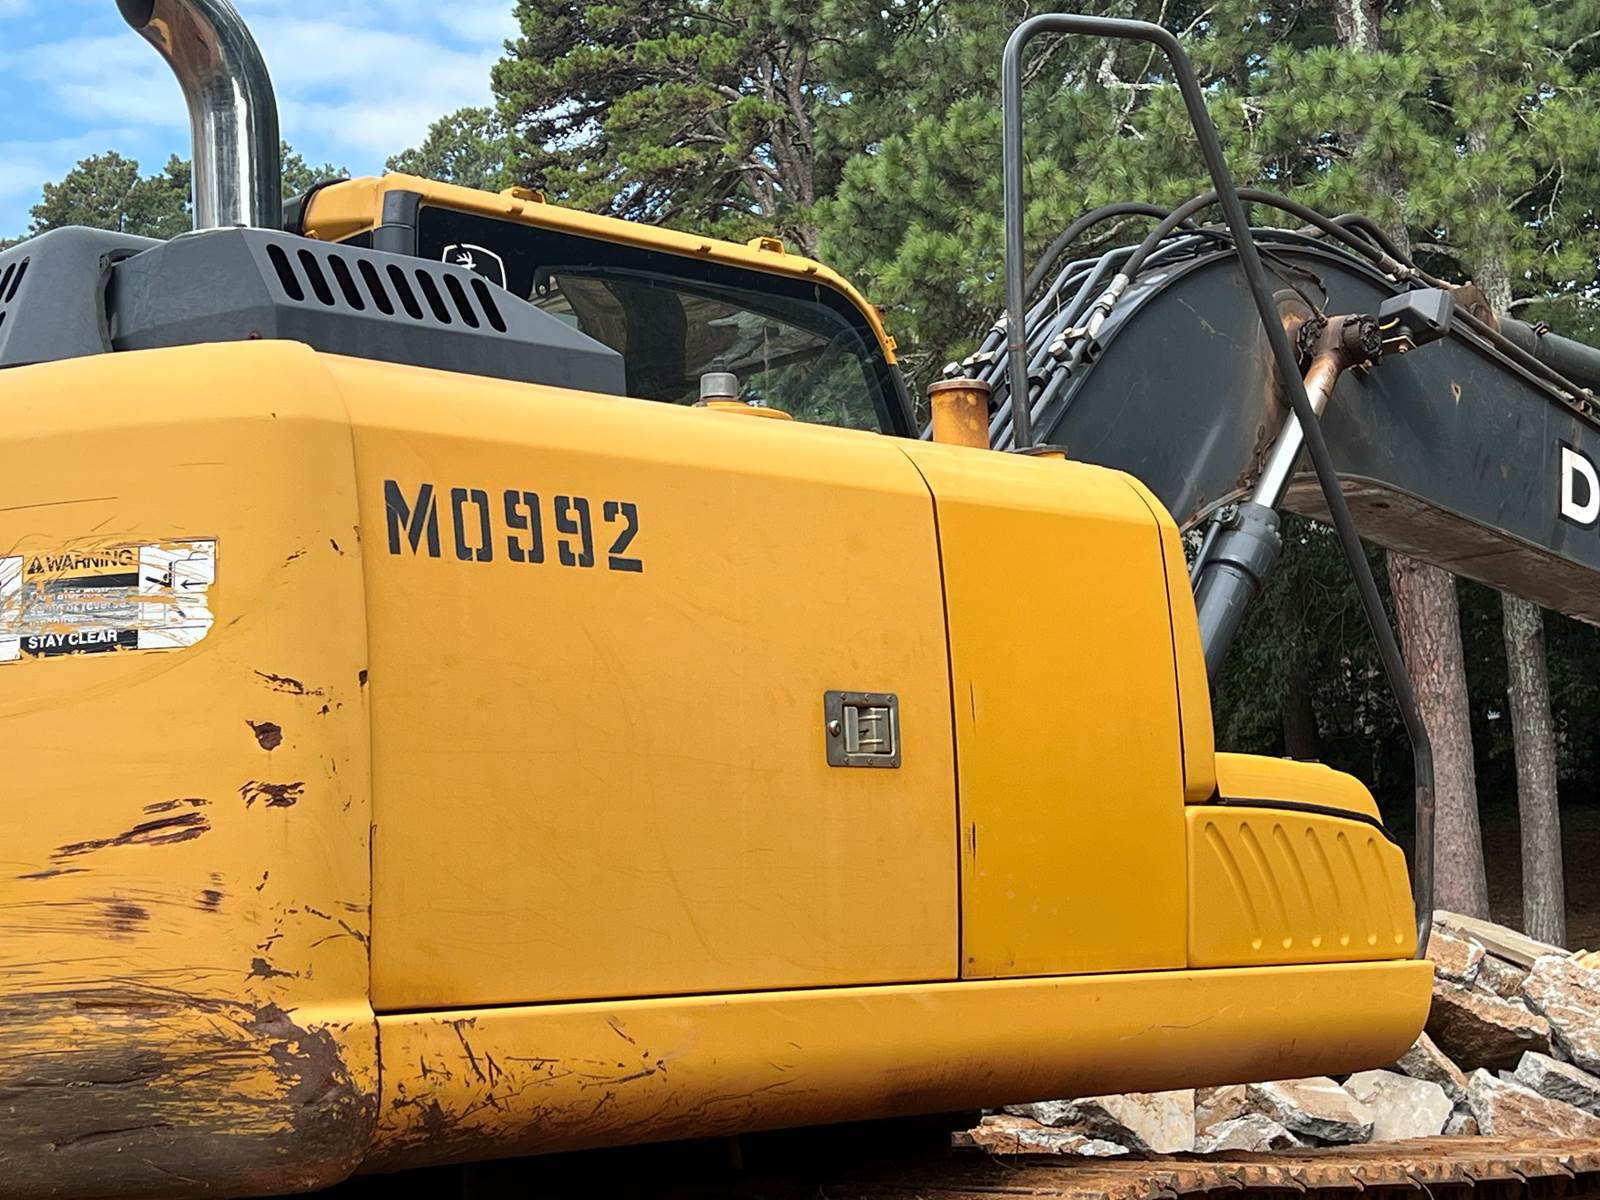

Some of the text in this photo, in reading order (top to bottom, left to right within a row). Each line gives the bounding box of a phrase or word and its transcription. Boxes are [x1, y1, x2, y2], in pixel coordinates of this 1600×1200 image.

[1561, 446, 1600, 524] D
[47, 550, 132, 572] WARNING
[28, 630, 117, 649] STAY CLEAR
